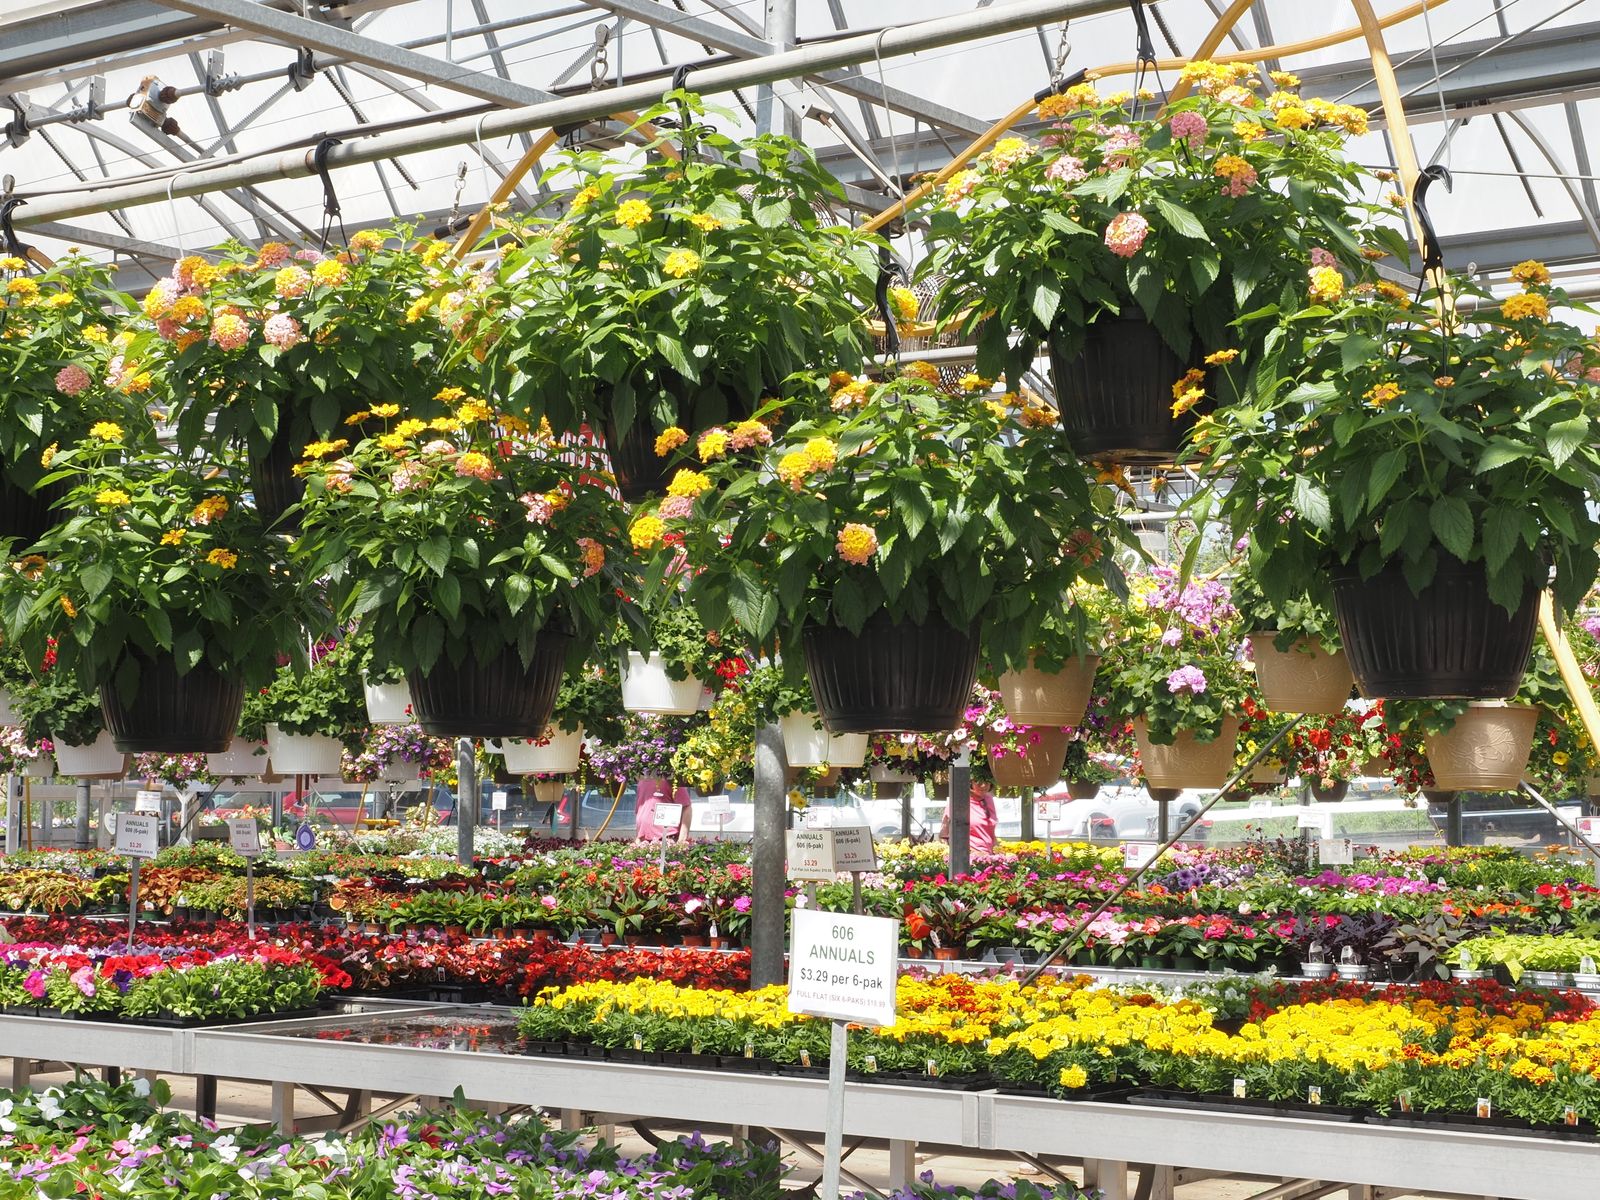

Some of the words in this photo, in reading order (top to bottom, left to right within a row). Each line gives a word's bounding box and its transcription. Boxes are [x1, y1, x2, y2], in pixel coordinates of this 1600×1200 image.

[796, 833, 824, 841] ANNUALS
[832, 925, 854, 940] 606
[809, 944, 875, 965] ANNUALS
[800, 967, 828, 983] $3.29
[831, 974, 849, 986] per
[852, 974, 883, 989] 6-pak
[796, 990, 811, 999] FULL
[812, 991, 828, 1001] FLAT
